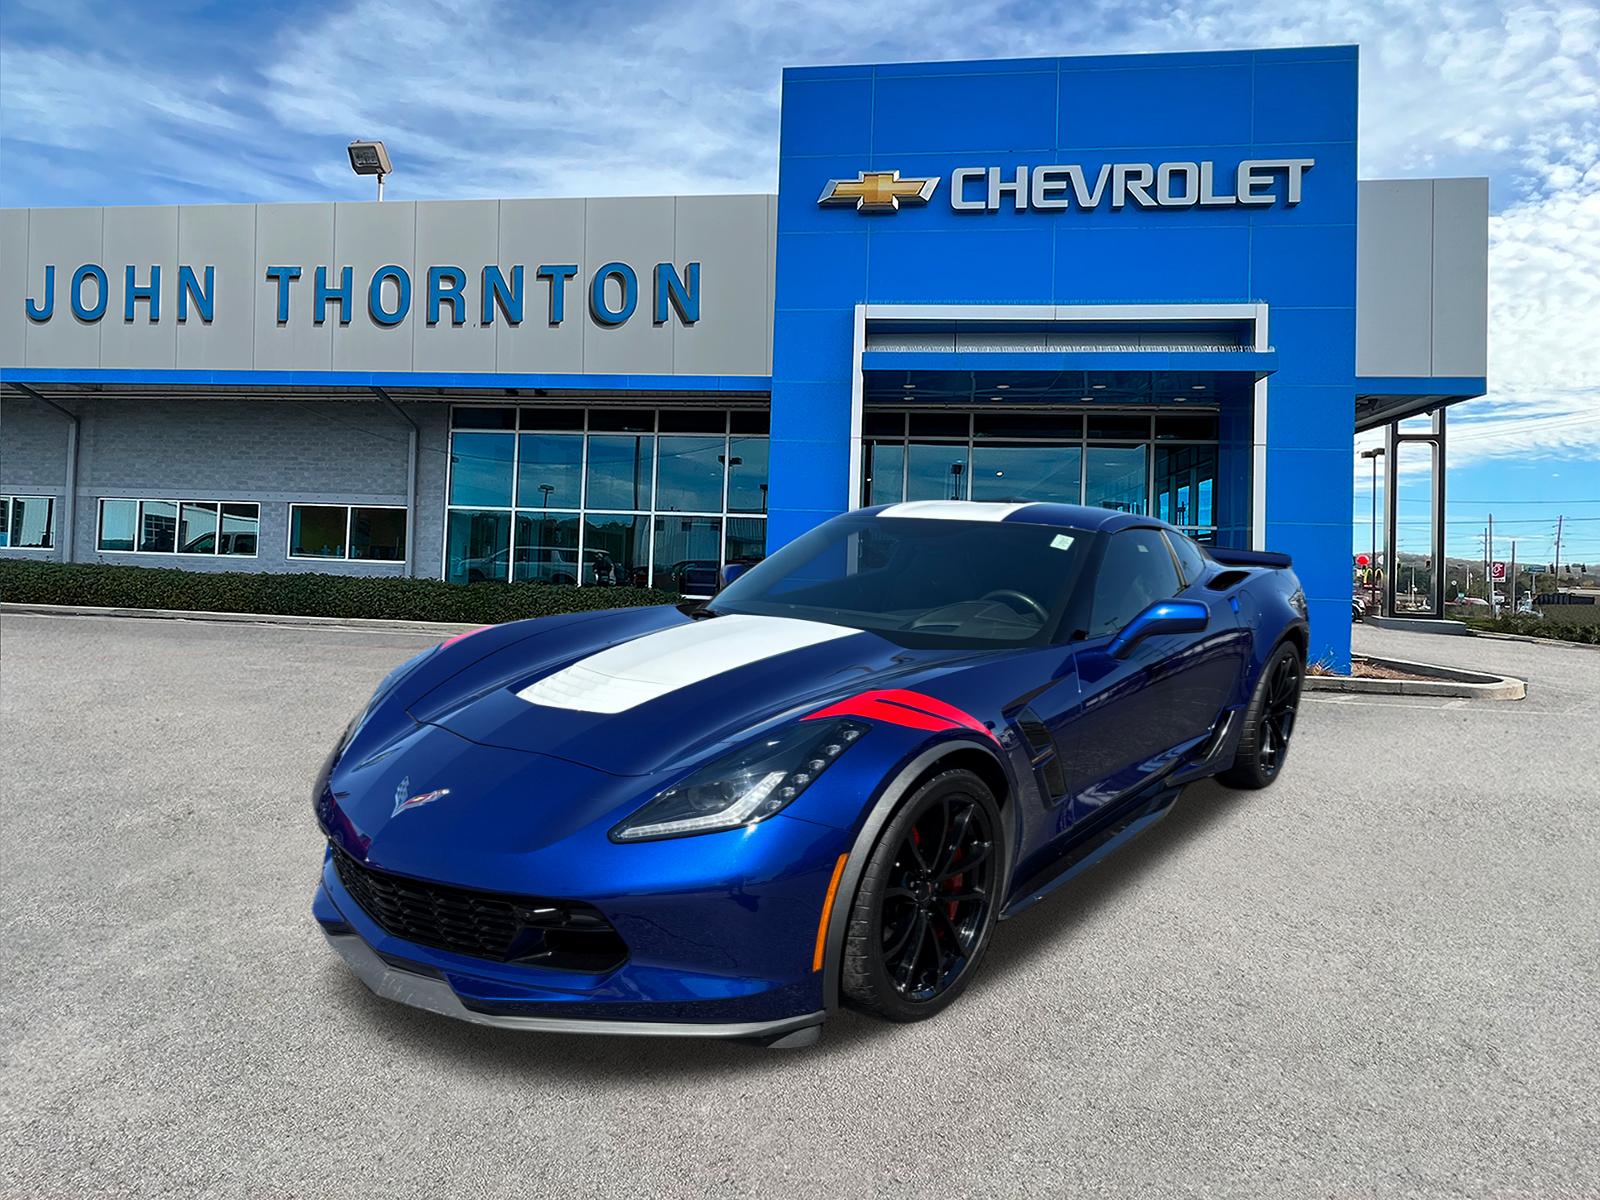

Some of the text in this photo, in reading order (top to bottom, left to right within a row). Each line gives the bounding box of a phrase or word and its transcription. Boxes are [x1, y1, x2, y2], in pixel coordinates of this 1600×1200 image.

[951, 158, 1315, 211] CHEVROLET
[26, 262, 701, 326] JOHN THORNTON
